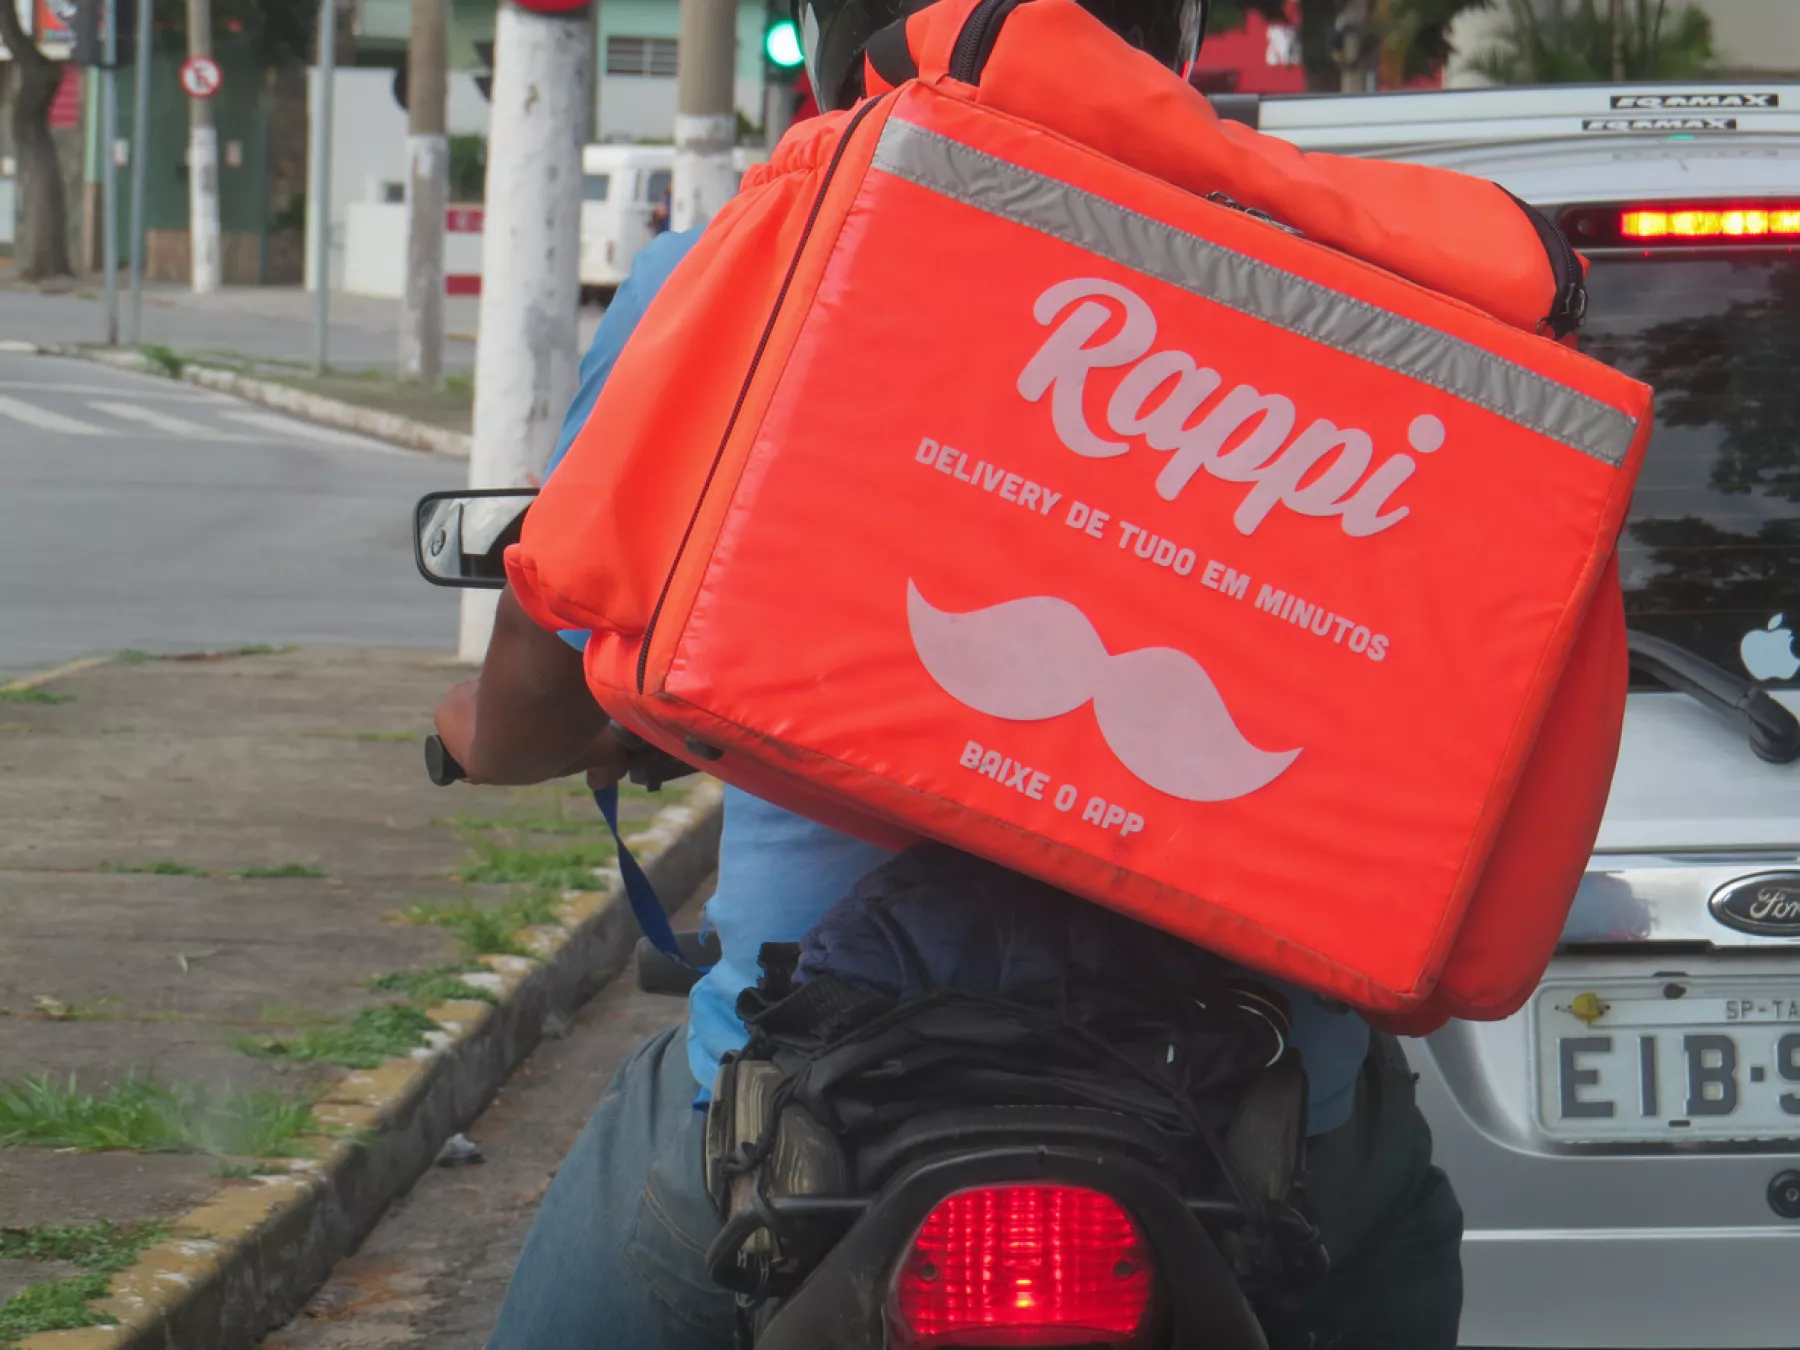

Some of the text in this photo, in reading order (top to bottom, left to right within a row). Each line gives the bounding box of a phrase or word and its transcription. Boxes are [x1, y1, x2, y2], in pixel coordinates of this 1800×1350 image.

[1016, 277, 1445, 537] Rappi
[916, 438, 1390, 662] DELIVERY DE TUDO EM MINUTOS
[960, 740, 1145, 837] BAIXE O APP
